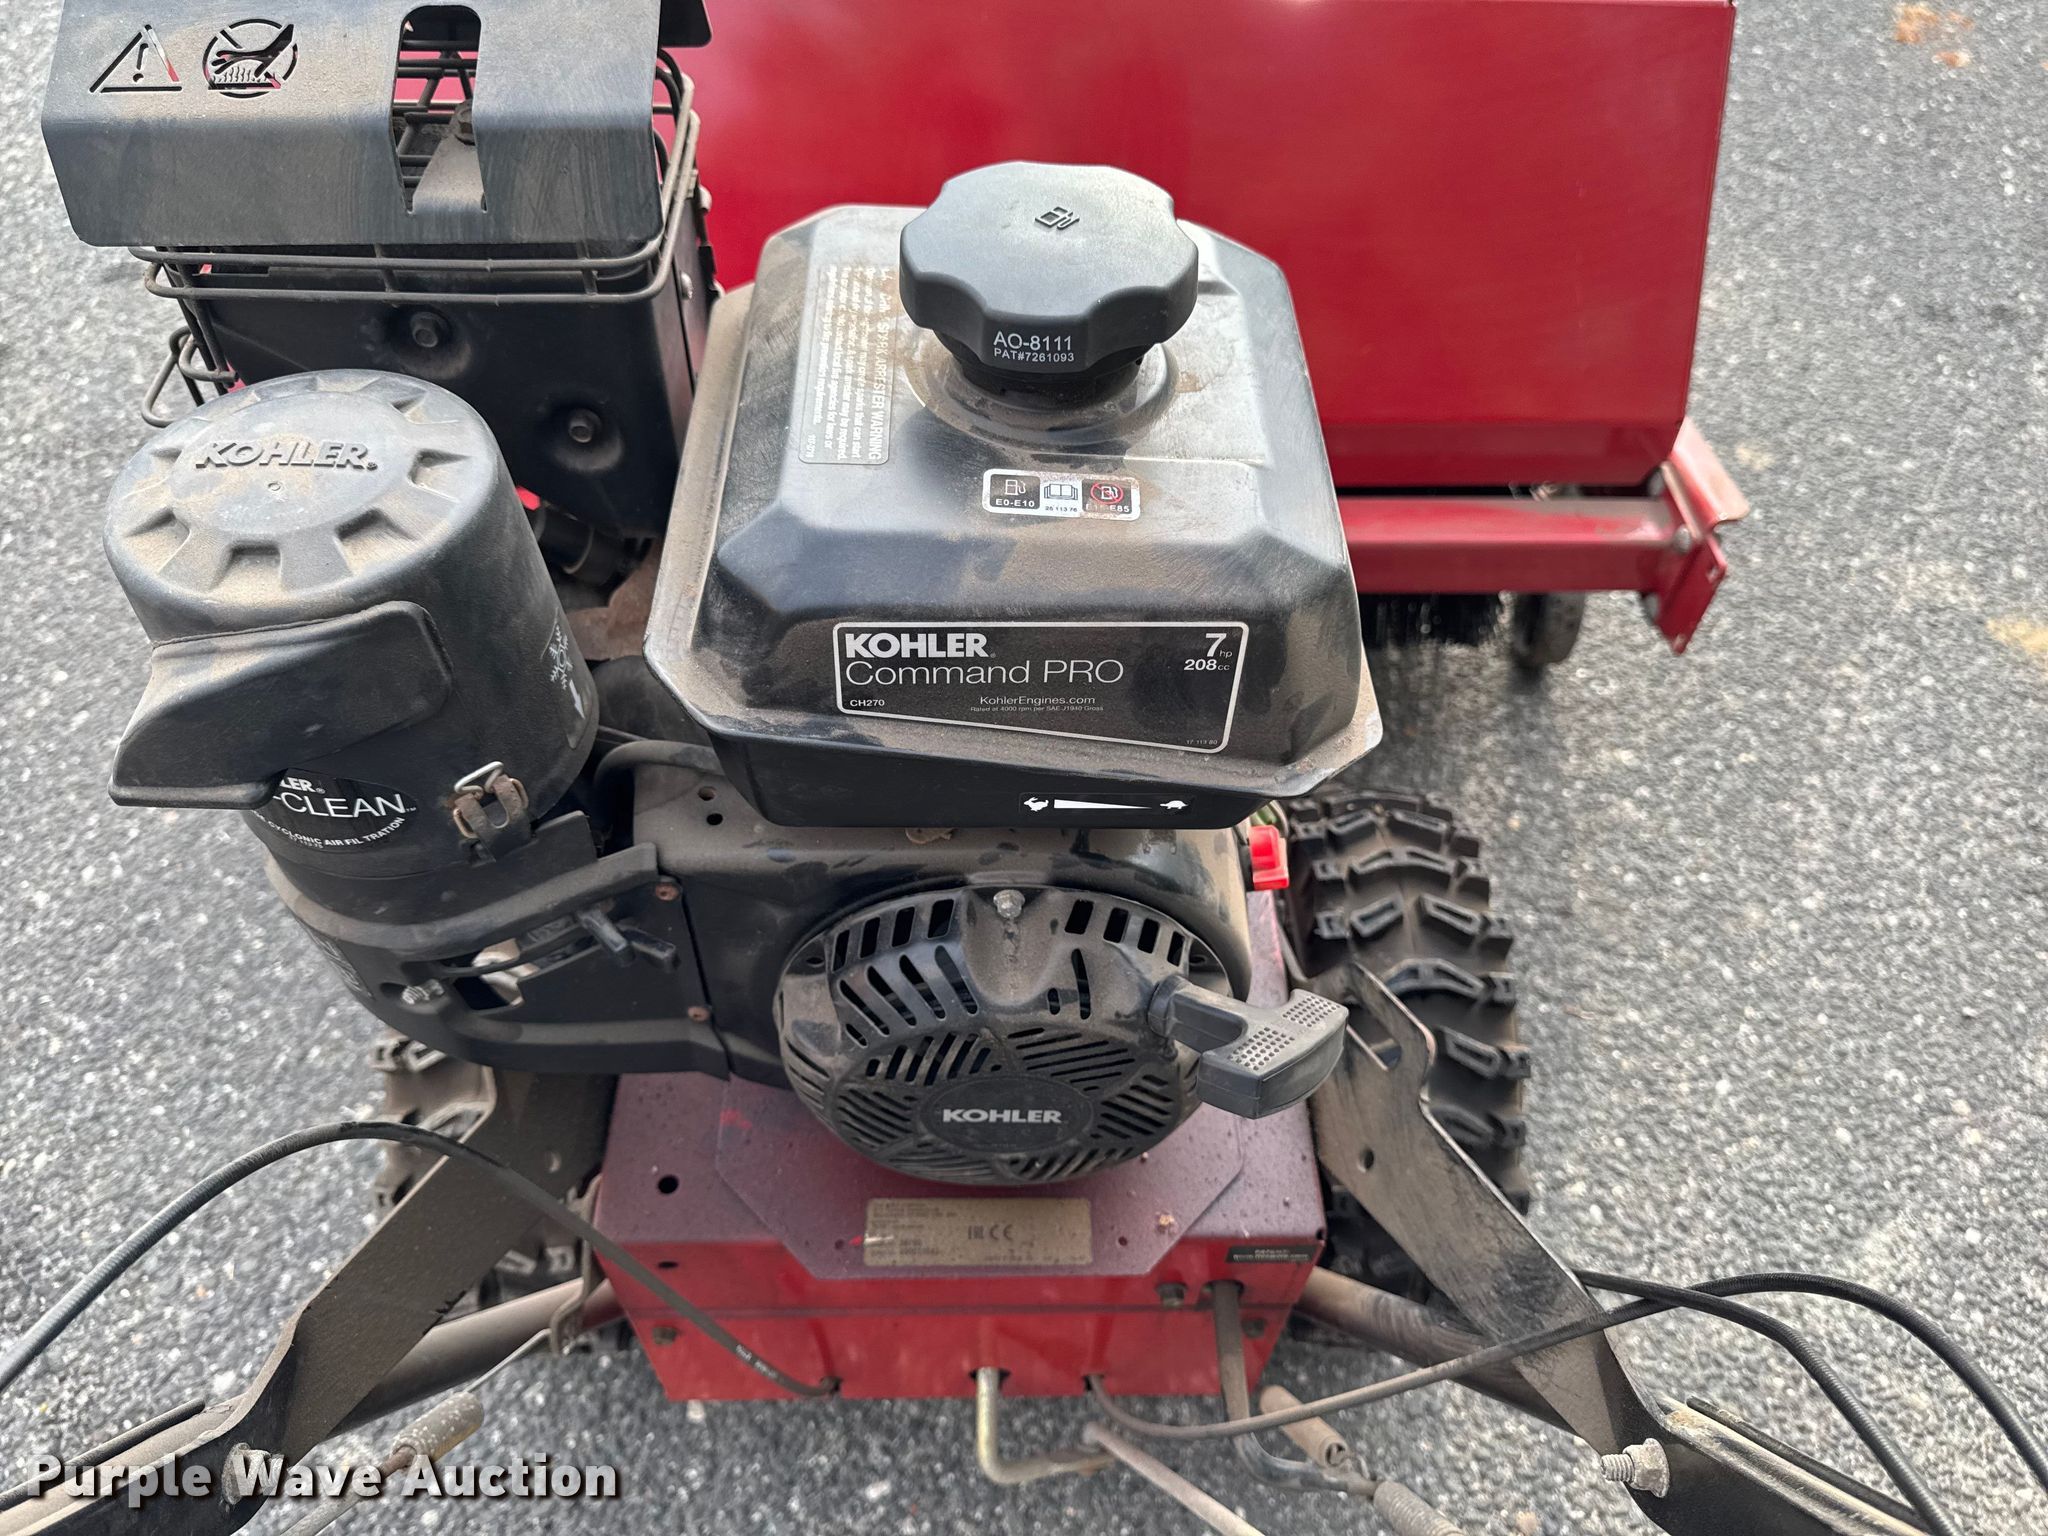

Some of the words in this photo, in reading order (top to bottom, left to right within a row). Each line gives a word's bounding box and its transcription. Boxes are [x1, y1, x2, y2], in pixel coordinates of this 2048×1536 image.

[994, 331, 1072, 351] AO-8111
[994, 348, 1074, 362] PAT#7261093
[853, 426, 861, 439] can
[868, 410, 885, 460] WARNING
[824, 440, 832, 449] or
[851, 441, 860, 457] start
[196, 442, 369, 470] KOHLER
[996, 499, 1035, 508] E0-E10
[1085, 504, 1130, 512] E1-E85
[845, 633, 989, 658] KOHLER
[846, 660, 1030, 686] Command
[1044, 660, 1124, 684] PRO
[850, 699, 885, 707] CH270
[980, 696, 1095, 706] KohlerEngines.com
[280, 776, 316, 792] LER
[272, 792, 406, 818] -CLEAN
[943, 1108, 1062, 1123] KOHLER
